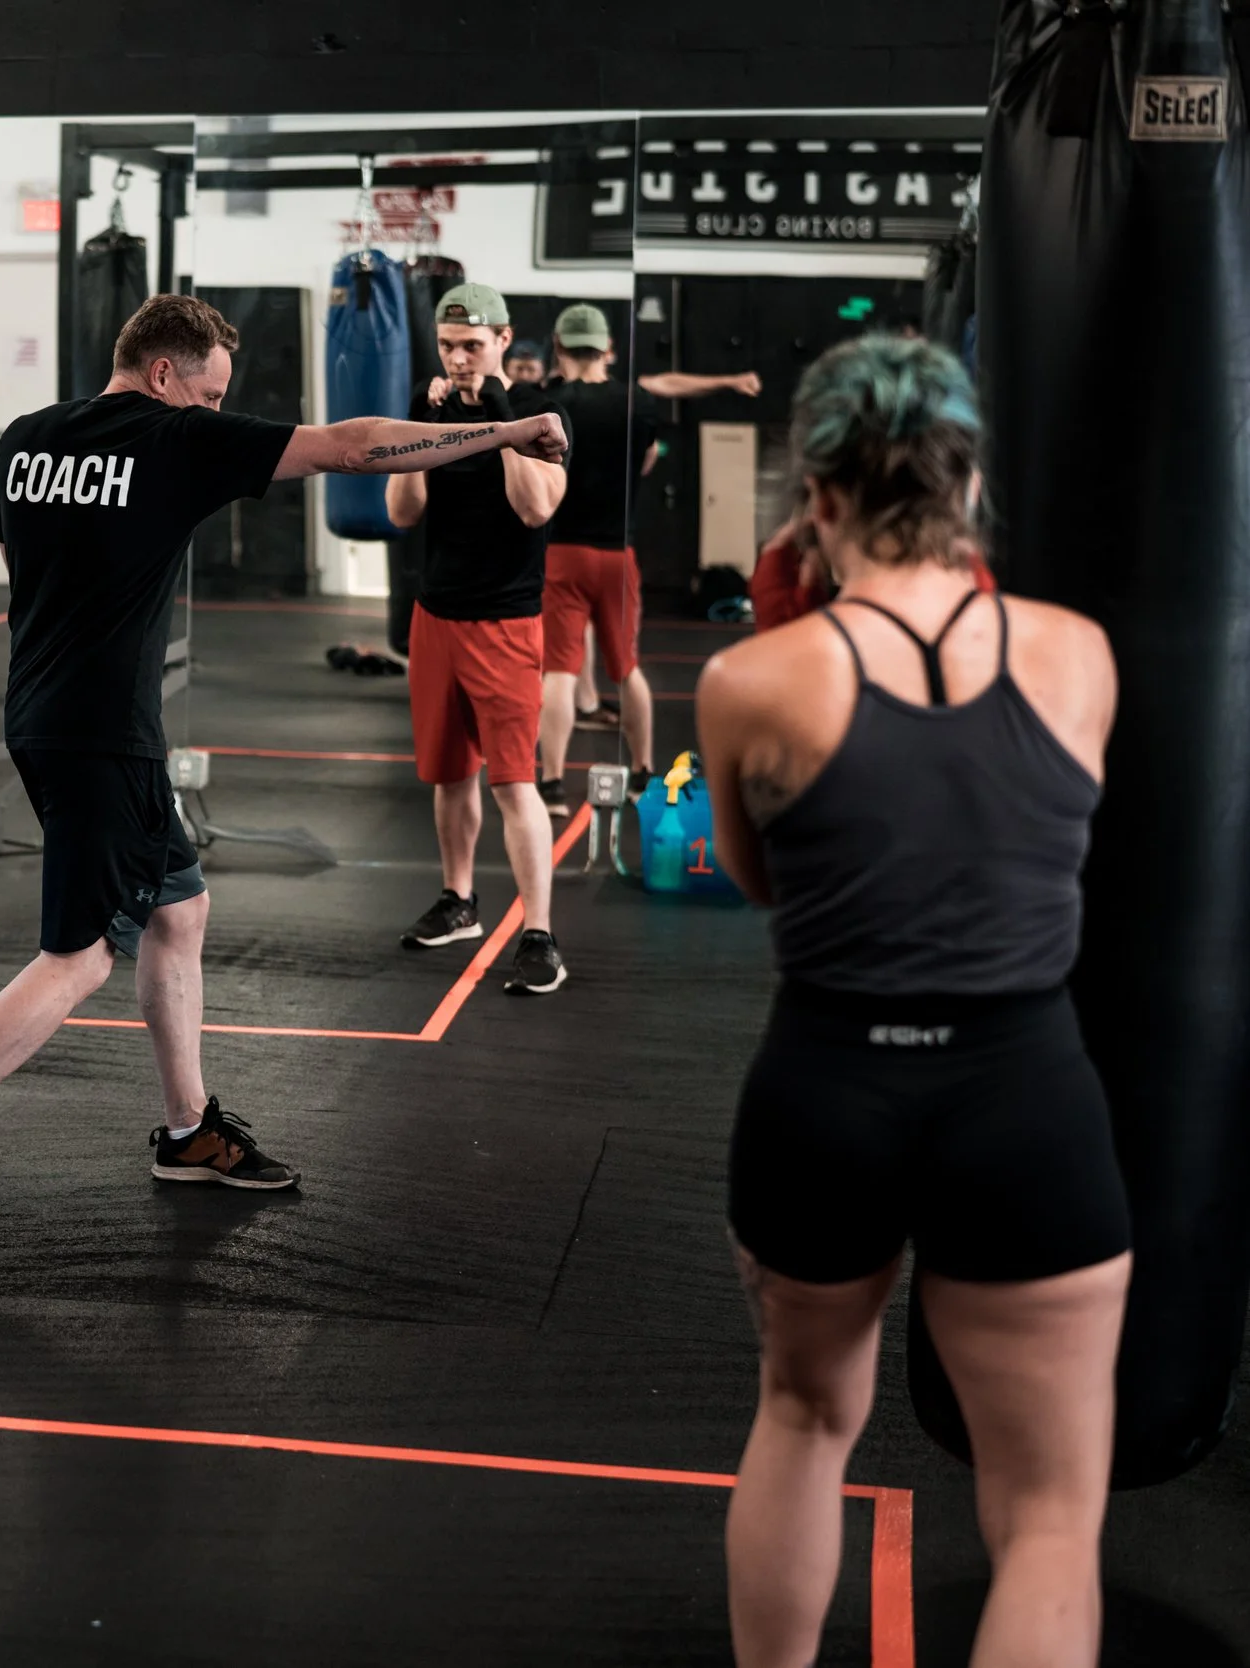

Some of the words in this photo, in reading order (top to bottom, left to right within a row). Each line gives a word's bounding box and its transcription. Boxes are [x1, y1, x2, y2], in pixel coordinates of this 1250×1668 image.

[1144, 87, 1218, 125] SELECT
[364, 437, 434, 463] Stand
[6, 451, 135, 507] COACH
[688, 836, 714, 874] 1
